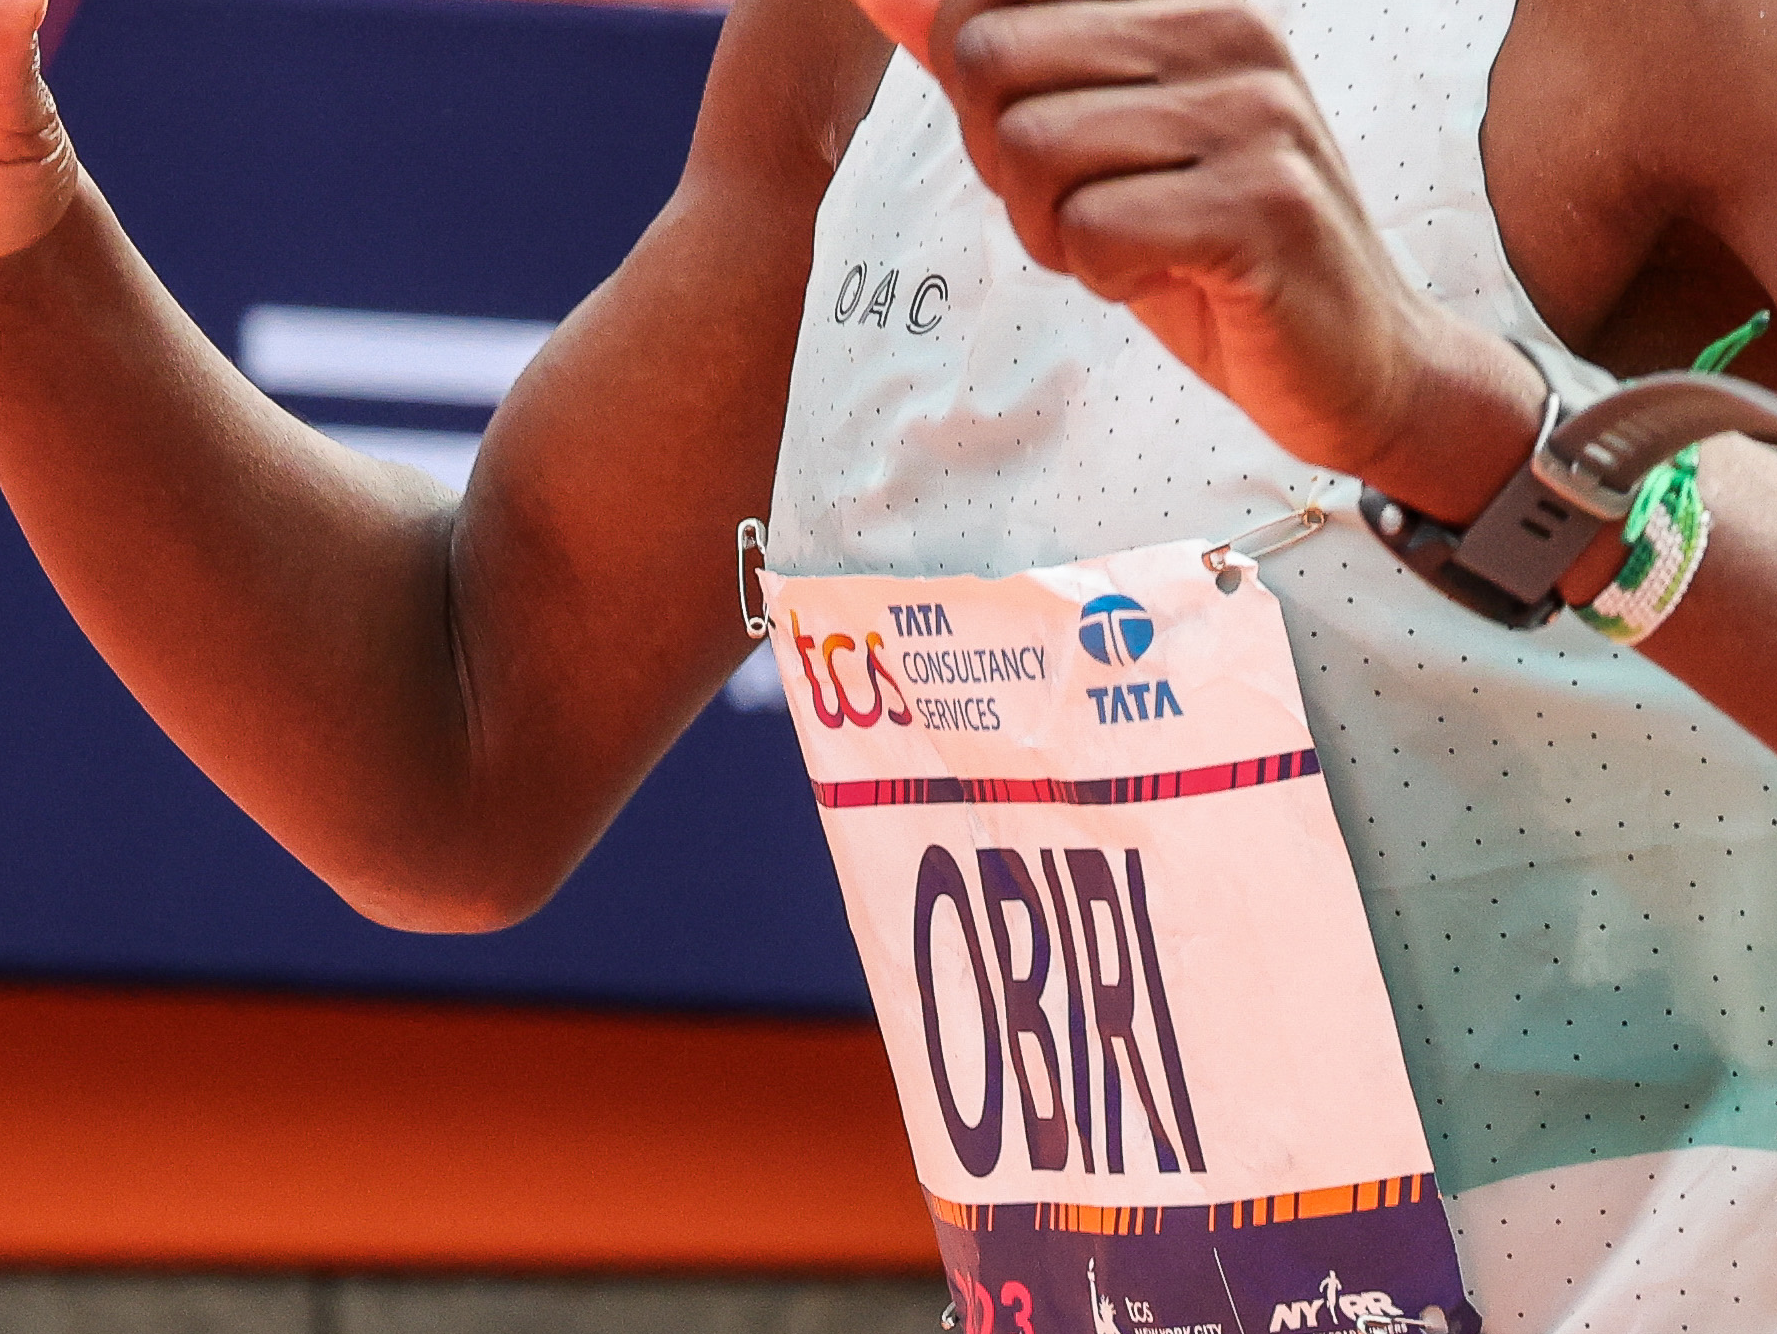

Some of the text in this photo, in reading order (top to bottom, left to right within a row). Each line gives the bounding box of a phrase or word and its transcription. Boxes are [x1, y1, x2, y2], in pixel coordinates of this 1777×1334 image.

[835, 260, 949, 335] OAC
[888, 602, 953, 637] TATA
[789, 608, 913, 729] tcs
[902, 644, 1046, 685] CONSULTANCY
[916, 697, 1001, 732] SERVICES
[1086, 679, 1184, 725] TATA
[913, 843, 1208, 1178] OBIRI
[1124, 1296, 1154, 1323] tcs
